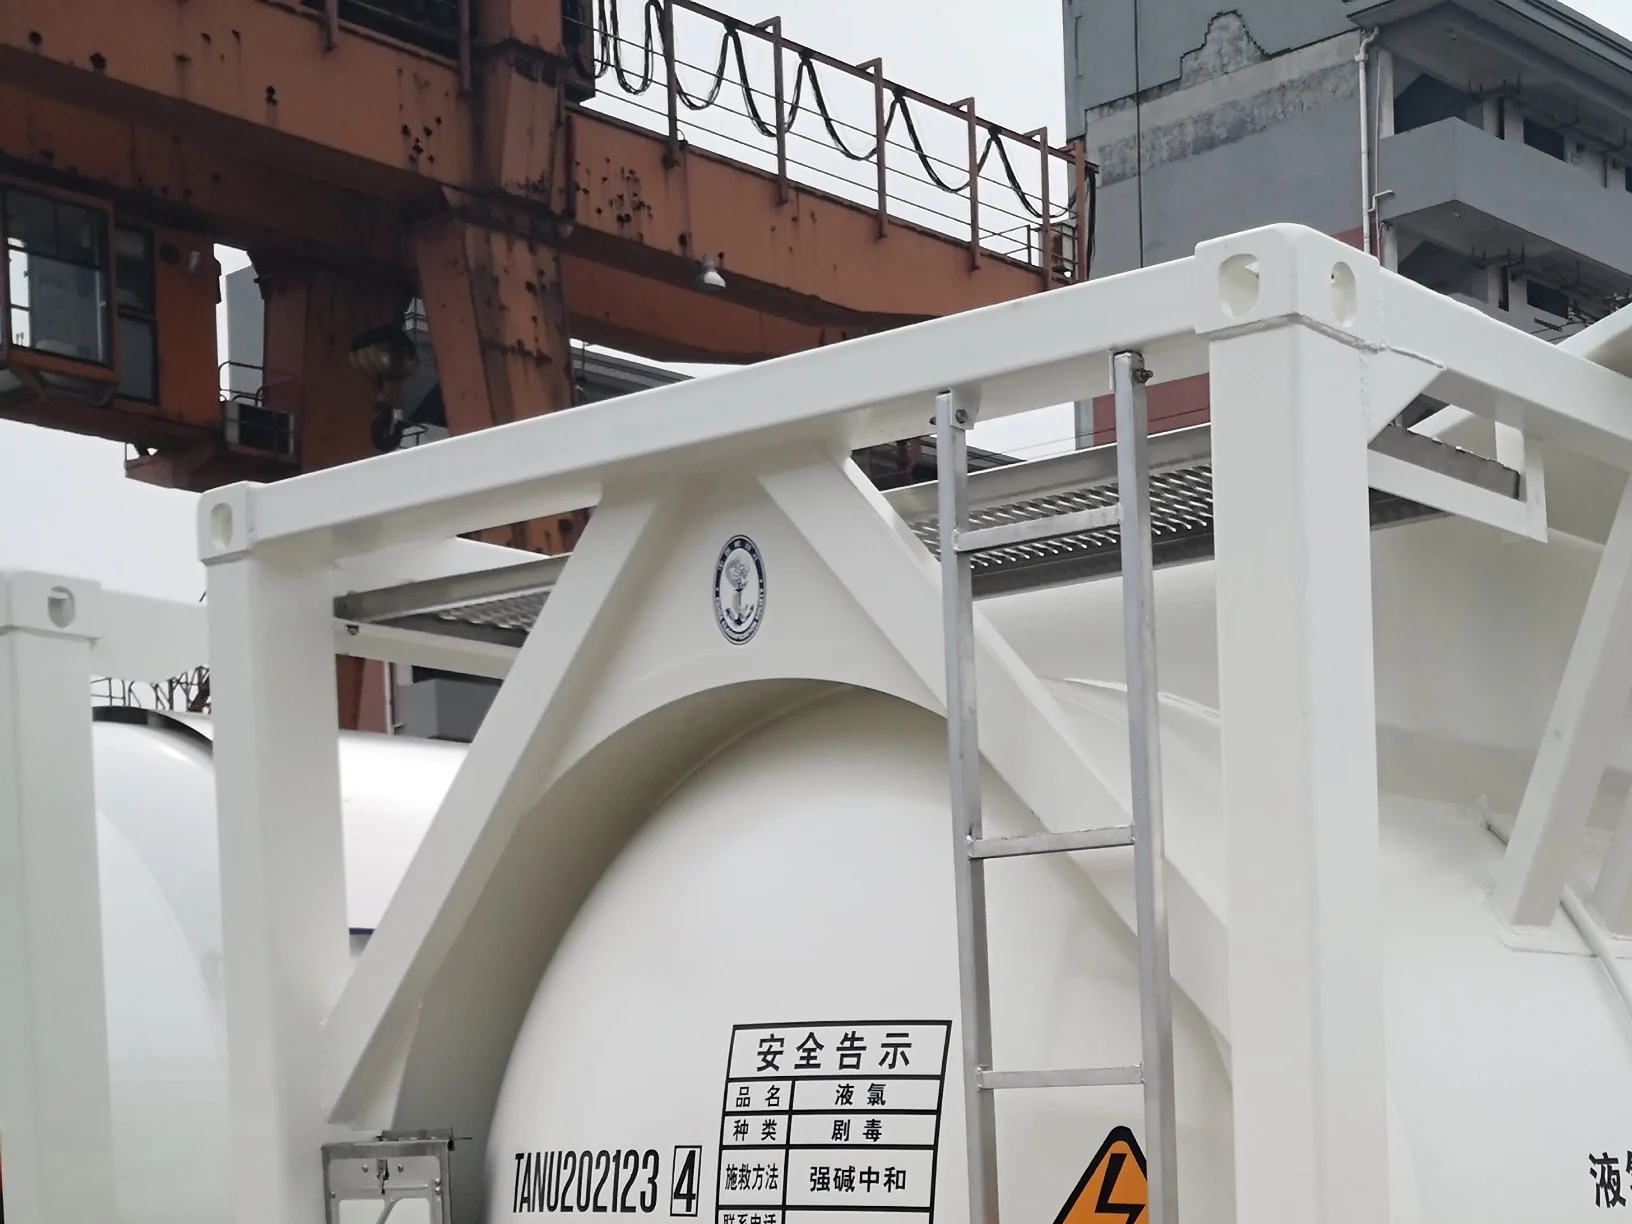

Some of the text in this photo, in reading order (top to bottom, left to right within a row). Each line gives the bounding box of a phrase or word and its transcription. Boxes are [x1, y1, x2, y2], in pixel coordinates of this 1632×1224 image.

[756, 1031, 912, 1072] 安全告示
[735, 1084, 781, 1108] 品名
[835, 1083, 886, 1107] 液氯
[733, 1120, 778, 1142] 种类
[831, 1119, 882, 1142] 剧毒
[513, 1149, 697, 1213] TANU202123 4
[724, 1163, 779, 1192] 施救方法
[809, 1166, 907, 1193] 强碱中和
